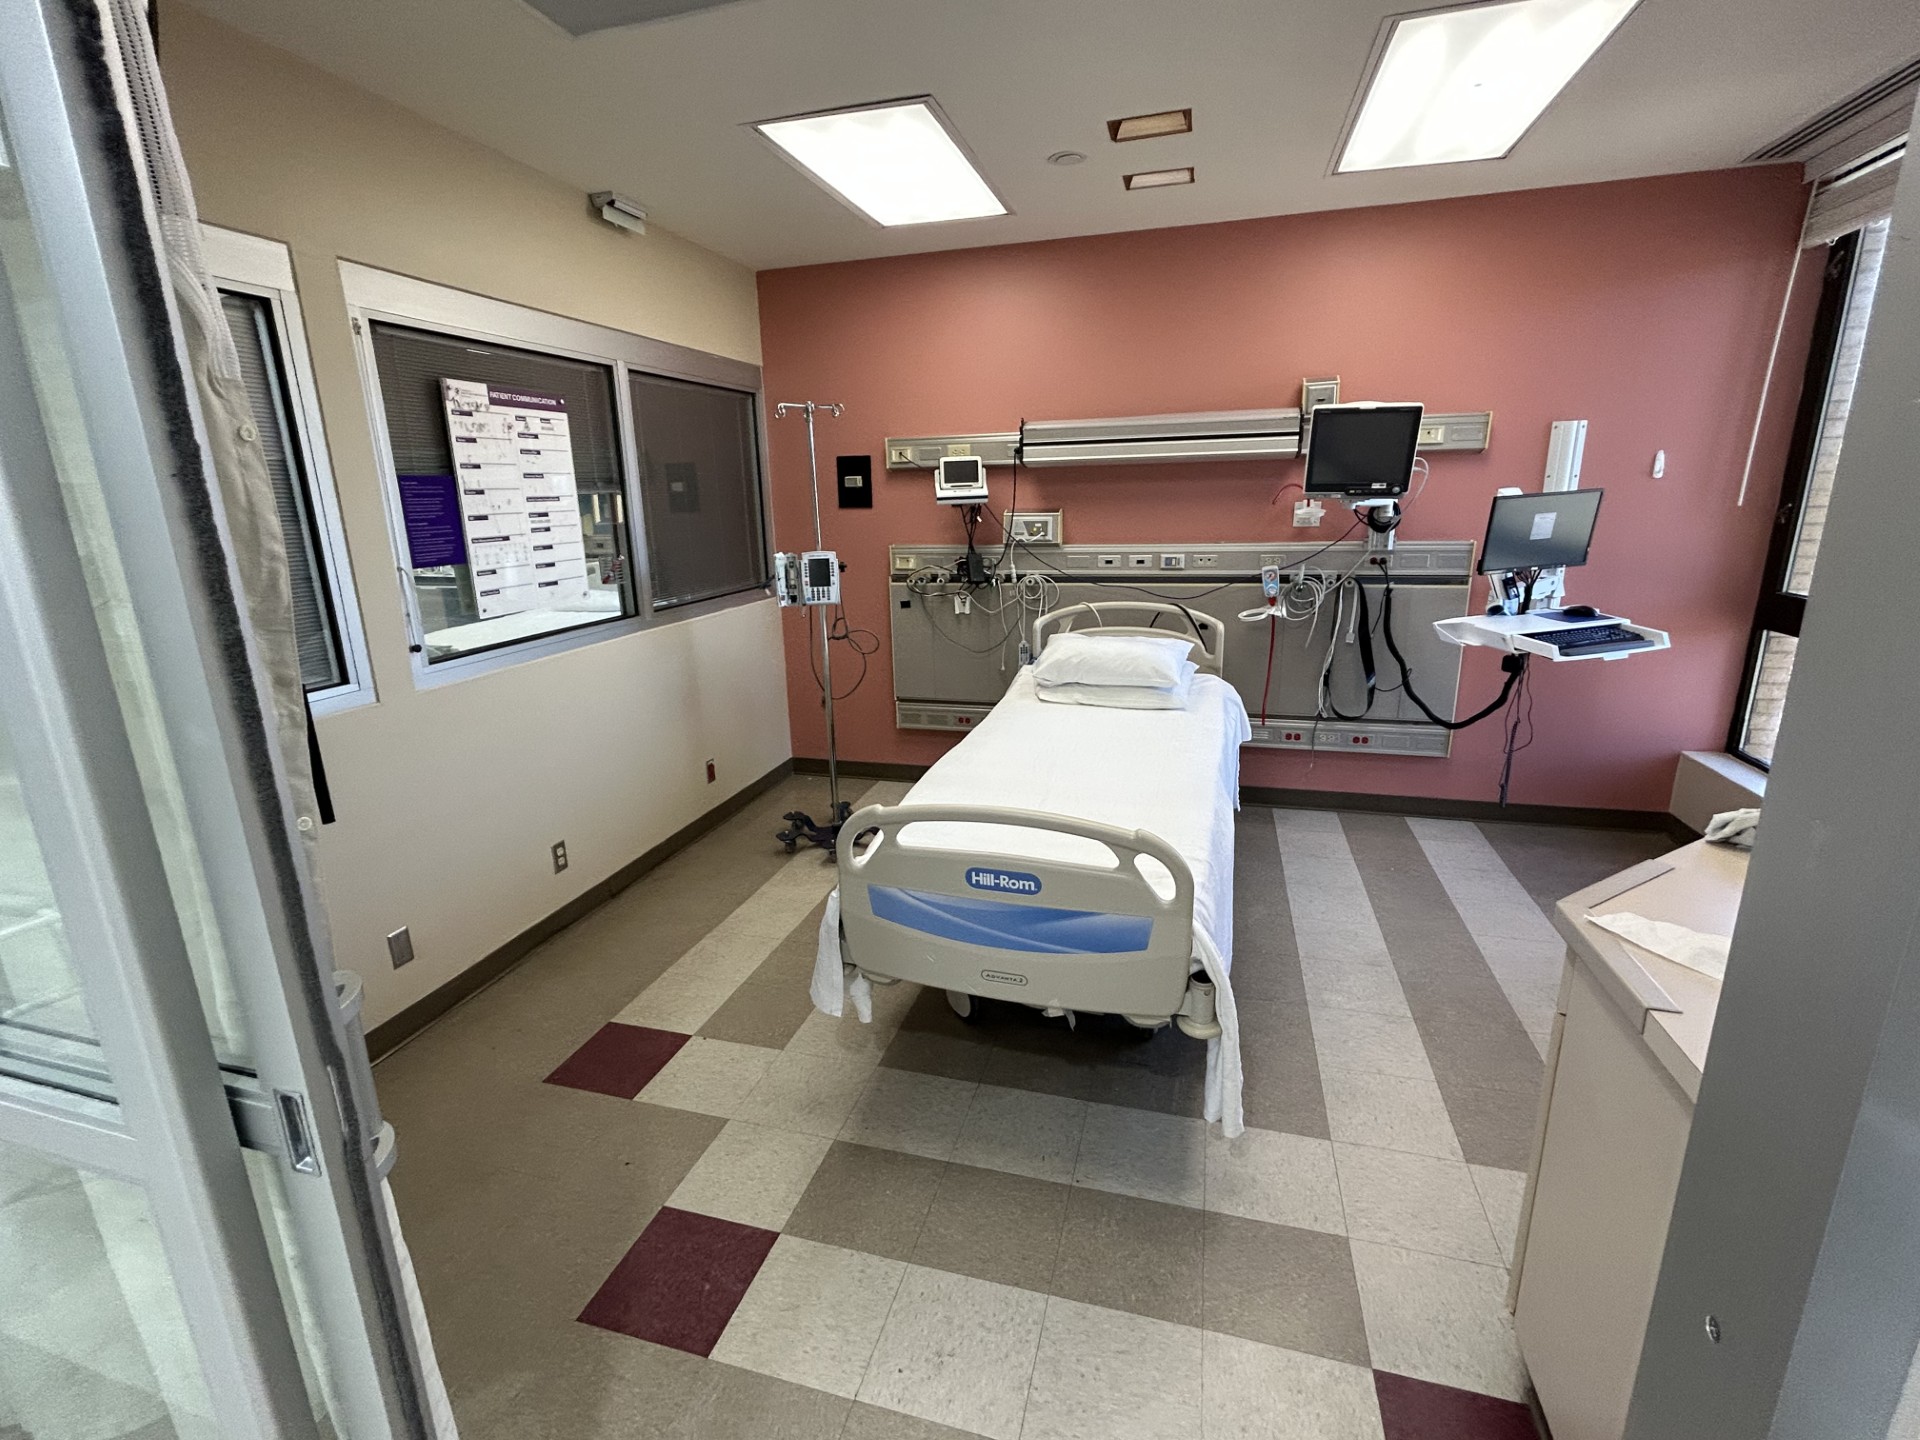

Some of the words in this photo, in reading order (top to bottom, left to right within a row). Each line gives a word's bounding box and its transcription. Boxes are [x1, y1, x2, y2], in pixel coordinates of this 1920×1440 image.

[489, 391, 512, 401] PATIENT
[512, 394, 557, 406] COMMUNICATION
[971, 871, 1036, 891] Hill-Rom
